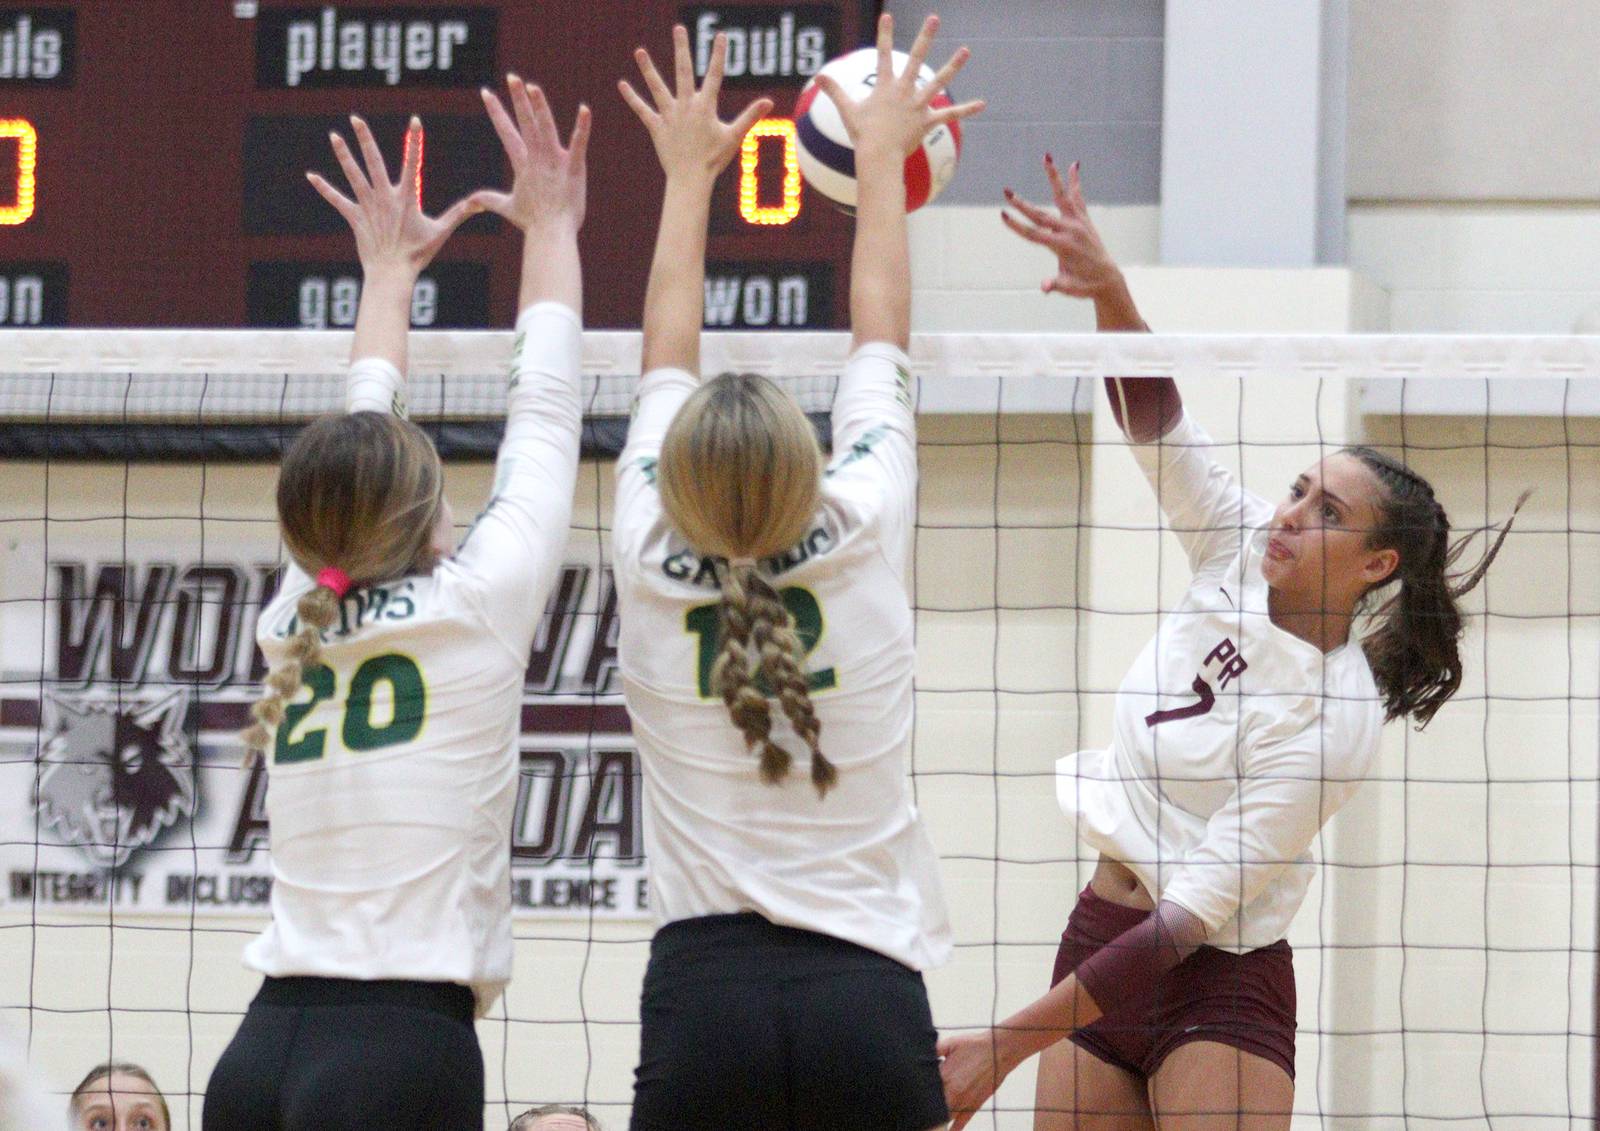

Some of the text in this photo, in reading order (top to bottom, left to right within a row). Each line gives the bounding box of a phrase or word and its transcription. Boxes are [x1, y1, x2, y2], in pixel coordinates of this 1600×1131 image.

[286, 8, 469, 86] player
[695, 12, 825, 77] fouls
[738, 117, 802, 226] 0
[300, 277, 437, 330] gae
[702, 276, 808, 326] won
[684, 585, 837, 700] 12
[1203, 637, 1248, 691] PR
[273, 652, 427, 765] 20
[1144, 673, 1216, 728] 7
[9, 871, 143, 904] INTEGRITY
